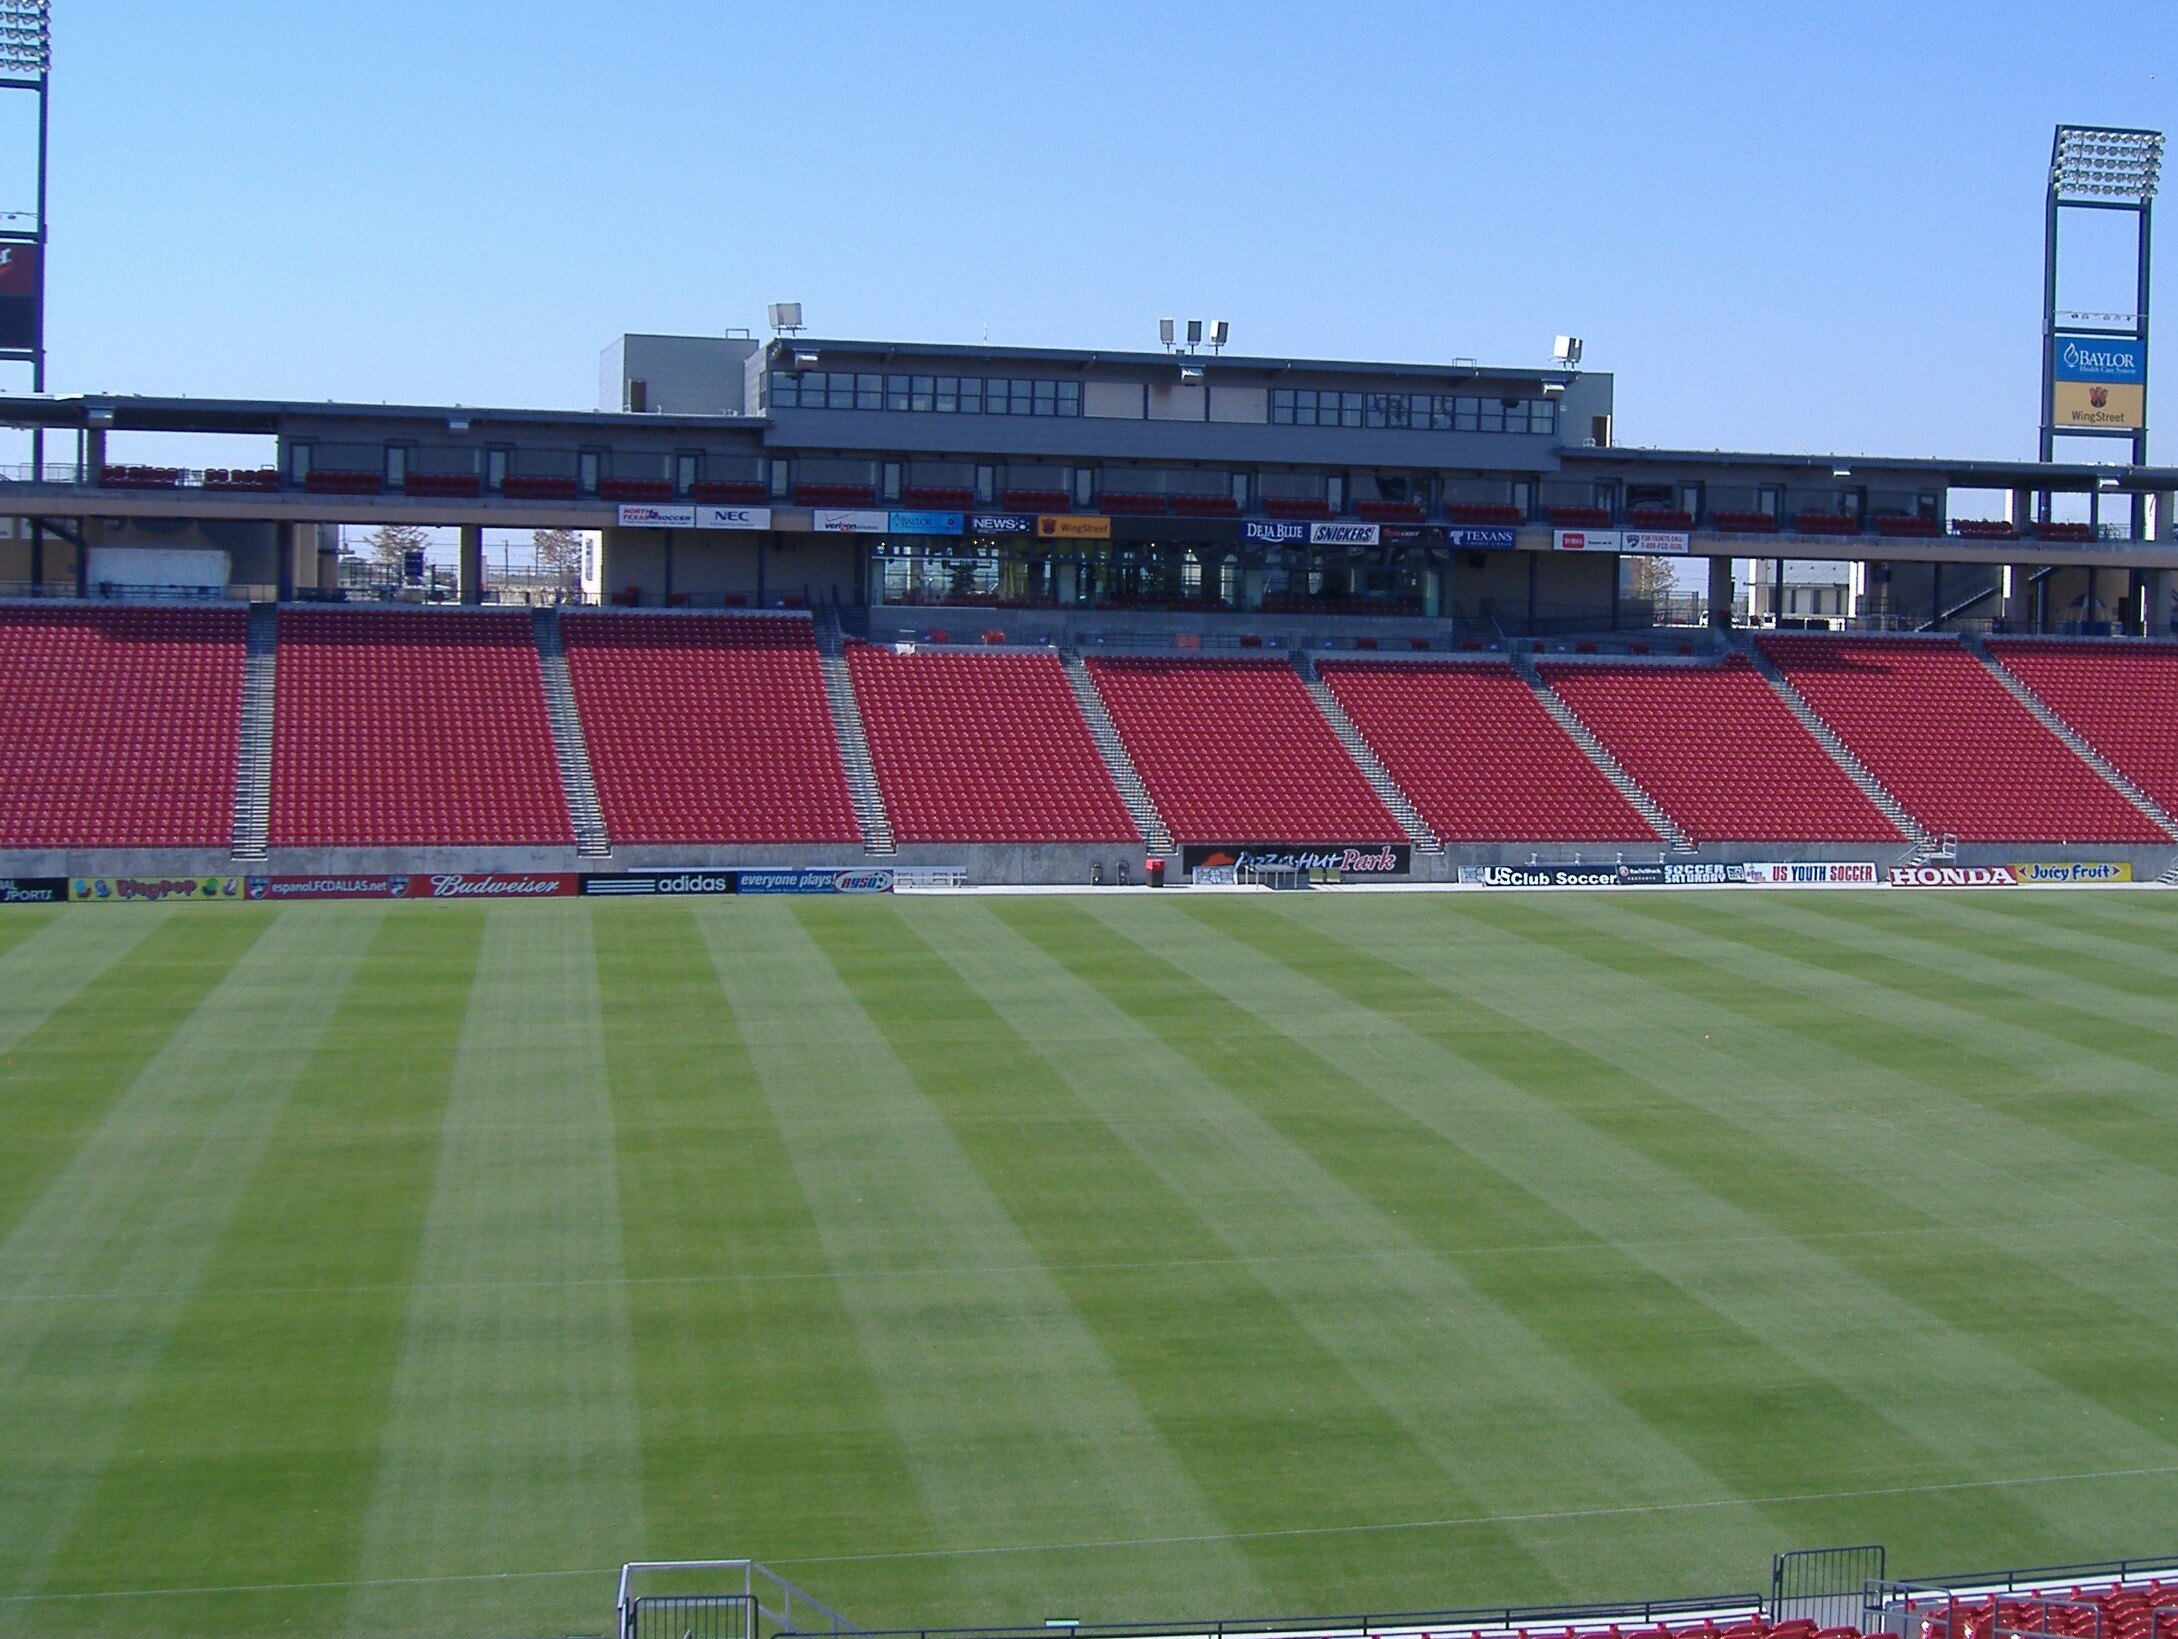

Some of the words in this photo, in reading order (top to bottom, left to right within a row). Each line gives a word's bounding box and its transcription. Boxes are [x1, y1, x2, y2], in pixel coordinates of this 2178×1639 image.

[2080, 350, 2135, 368] BAYLOR
[2072, 411, 2125, 423] WingStreet
[715, 511, 750, 522] NEC
[972, 518, 1016, 530] NEWS
[1061, 523, 1108, 535] WingStreet
[1277, 524, 1304, 538] BLUE
[1316, 525, 1374, 541] SNICKERS
[1464, 530, 1514, 541] TEXANS
[1296, 852, 1342, 870] Hut
[1340, 845, 1397, 872] Park
[1664, 864, 1725, 874] SOCCER
[1772, 865, 1788, 881] US
[1791, 865, 1826, 881] YOUTH
[1830, 865, 1873, 881] SOCCER
[2029, 863, 2070, 880] Juicy
[2072, 863, 2111, 882] Fruit
[658, 875, 726, 892] adidas
[741, 873, 797, 888] everyone
[1555, 871, 1617, 885] Soccer
[1664, 873, 1727, 883] SATURDAY
[1891, 867, 2019, 886] HONDA
[430, 874, 560, 896] Budweiser
